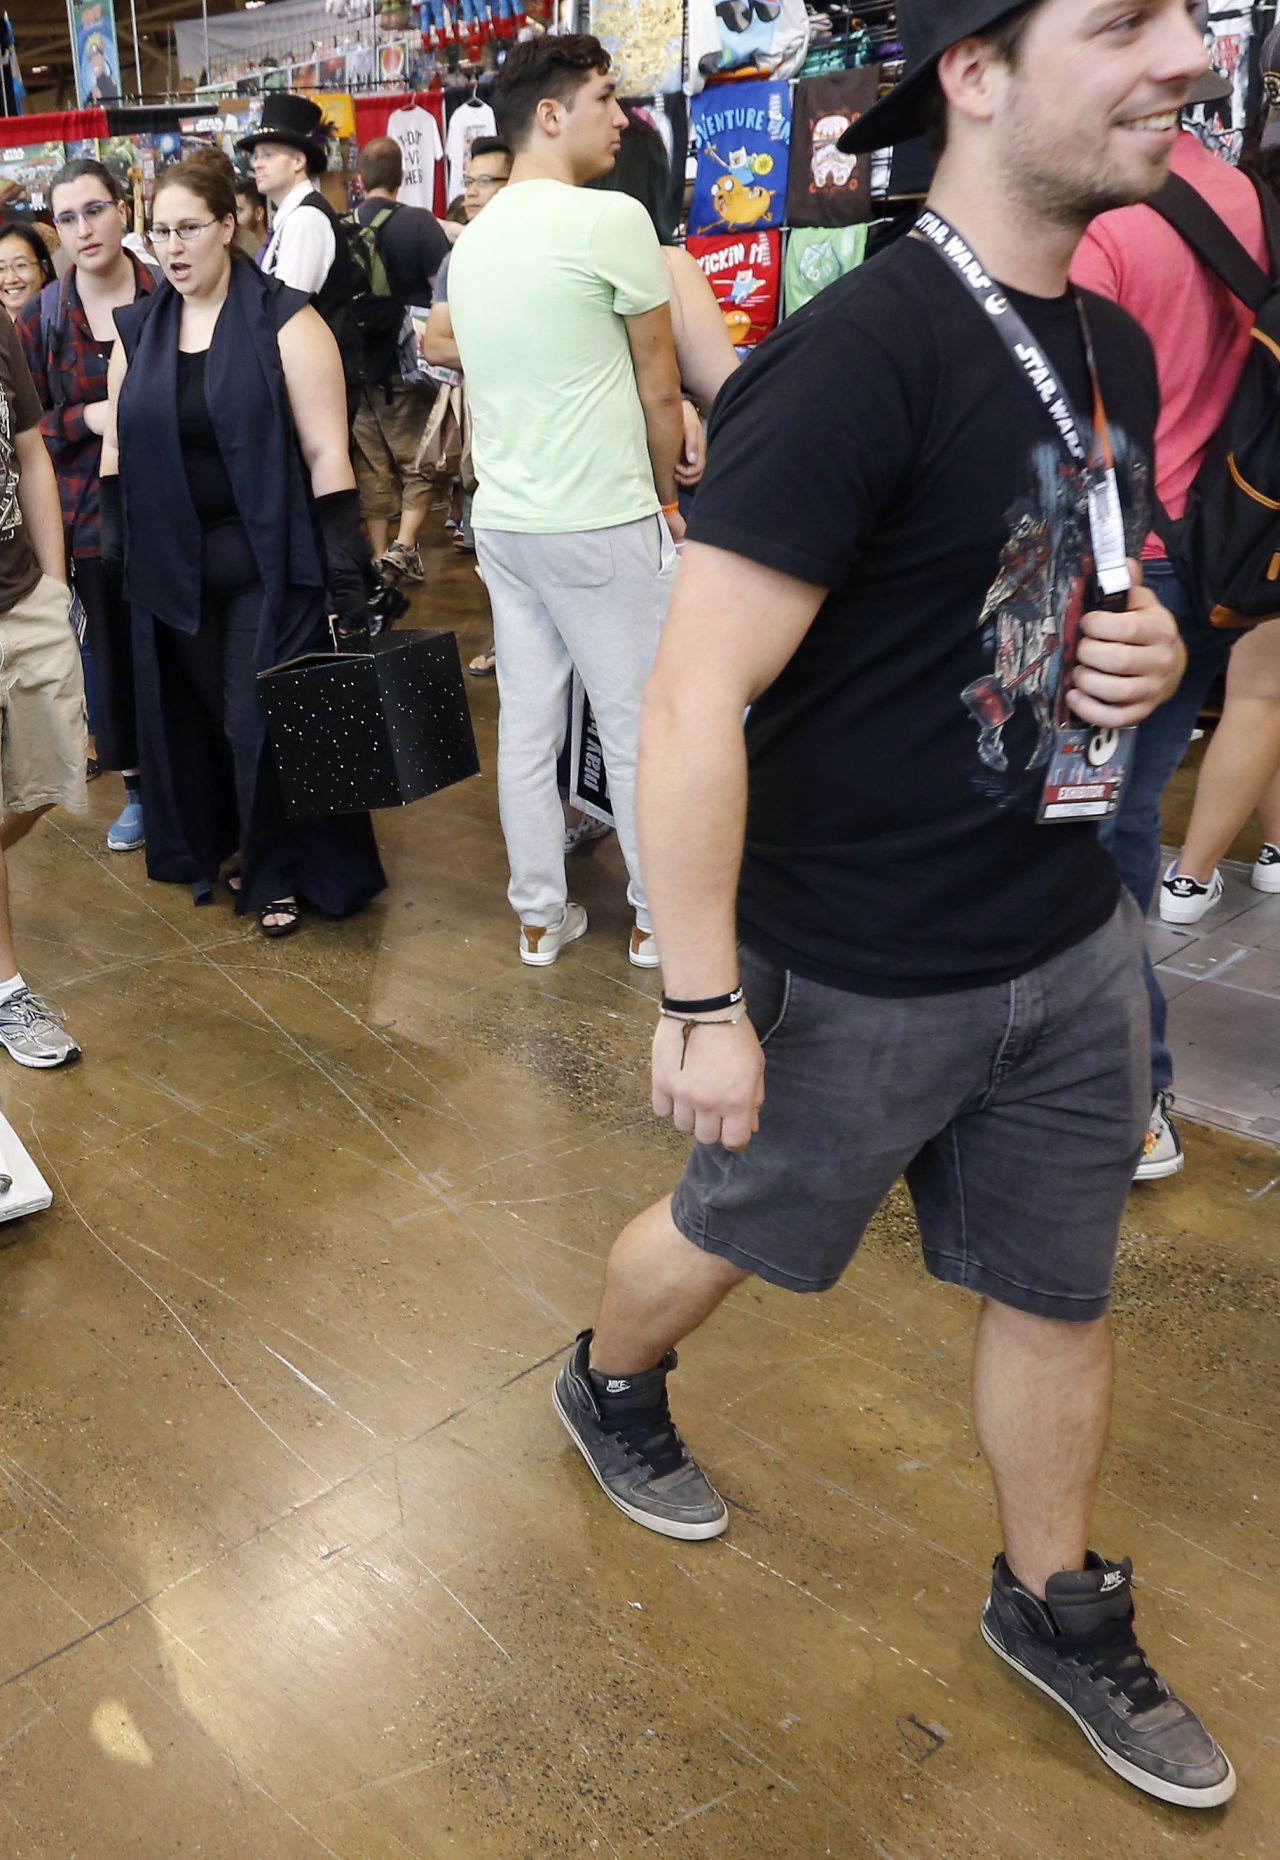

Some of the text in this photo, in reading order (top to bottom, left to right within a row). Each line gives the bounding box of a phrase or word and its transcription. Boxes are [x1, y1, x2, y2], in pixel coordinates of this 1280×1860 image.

[943, 234, 993, 289] WARS
[1013, 343, 1086, 459] STAR WARS
[607, 1379, 627, 1389] NIKE
[1103, 1570, 1121, 1586] NIKE
